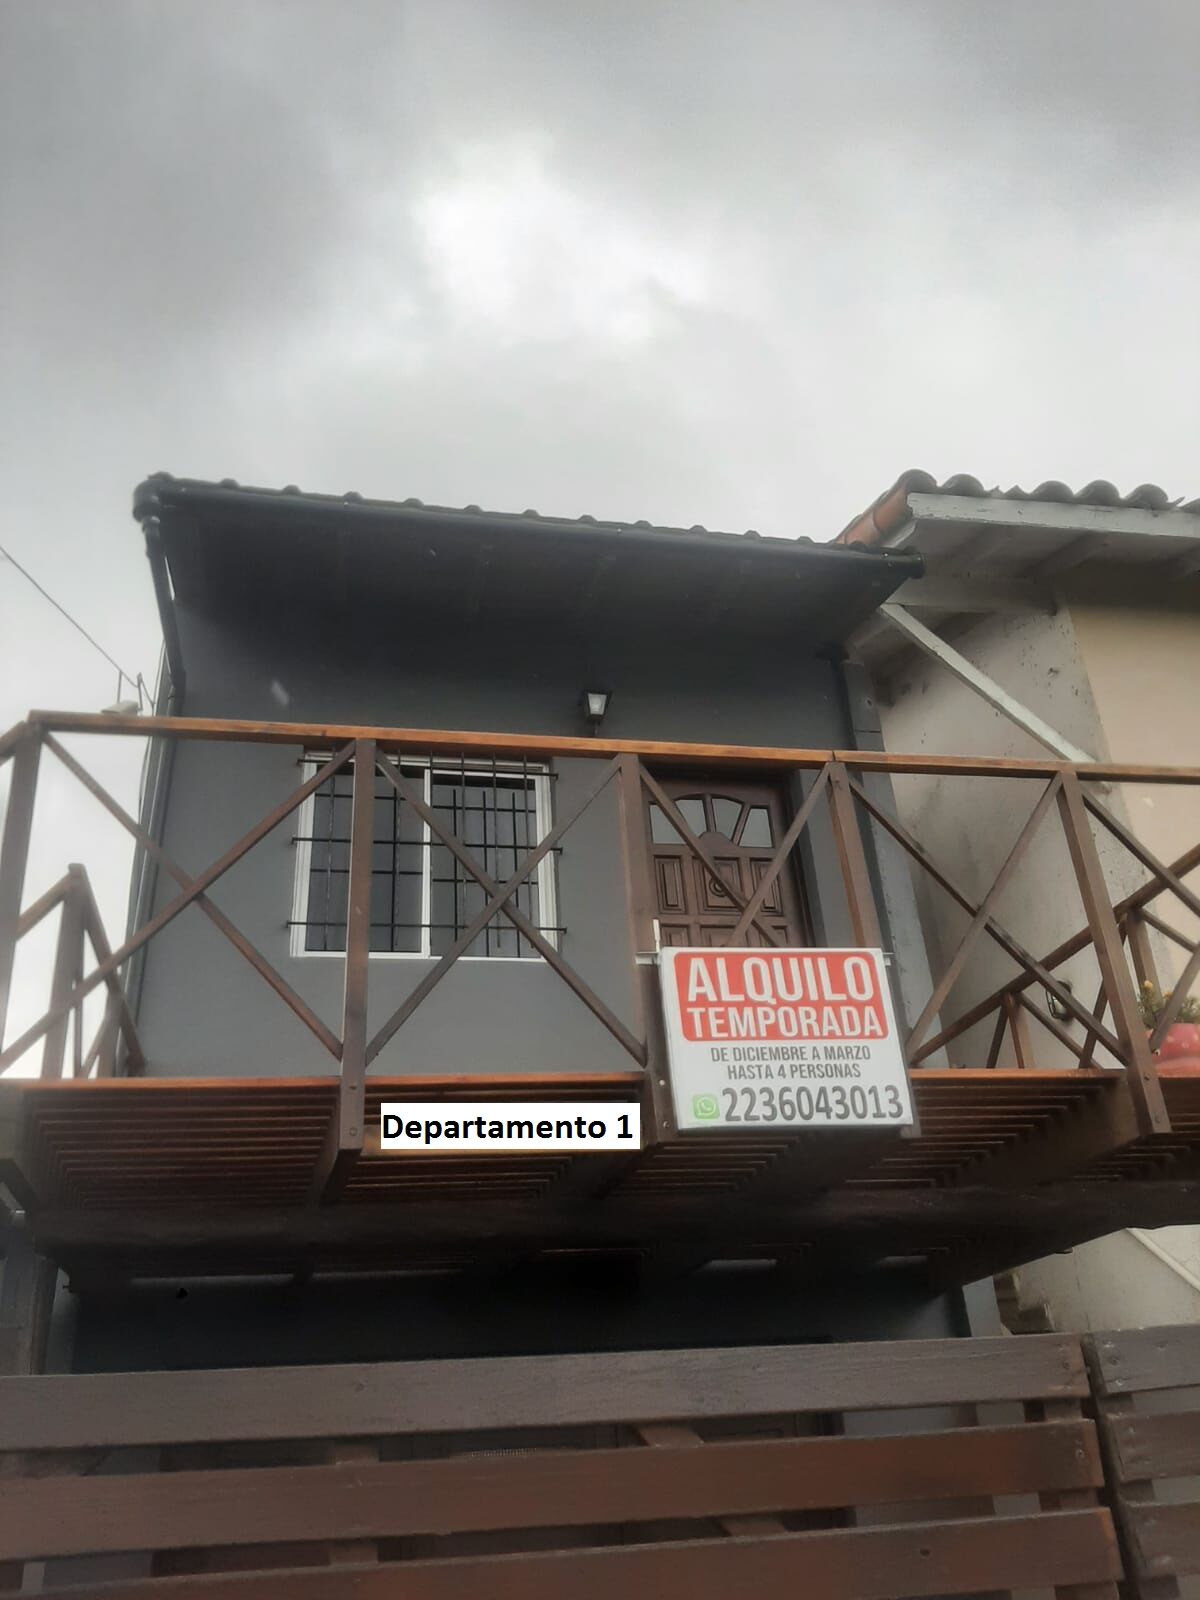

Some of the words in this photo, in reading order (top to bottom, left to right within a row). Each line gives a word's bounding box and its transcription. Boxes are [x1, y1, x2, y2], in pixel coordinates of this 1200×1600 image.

[687, 956, 874, 1005] ALQUILO
[687, 1005, 883, 1038] TEMPORADA
[711, 1047, 729, 1062] DE
[733, 1046, 808, 1062] DICIEMBRE
[812, 1046, 821, 1061] A
[824, 1045, 871, 1061] MARZO
[727, 1064, 773, 1080] HASTA
[777, 1064, 787, 1079] 4
[790, 1063, 861, 1079] PERSONAS
[721, 1085, 904, 1122] 2236043013
